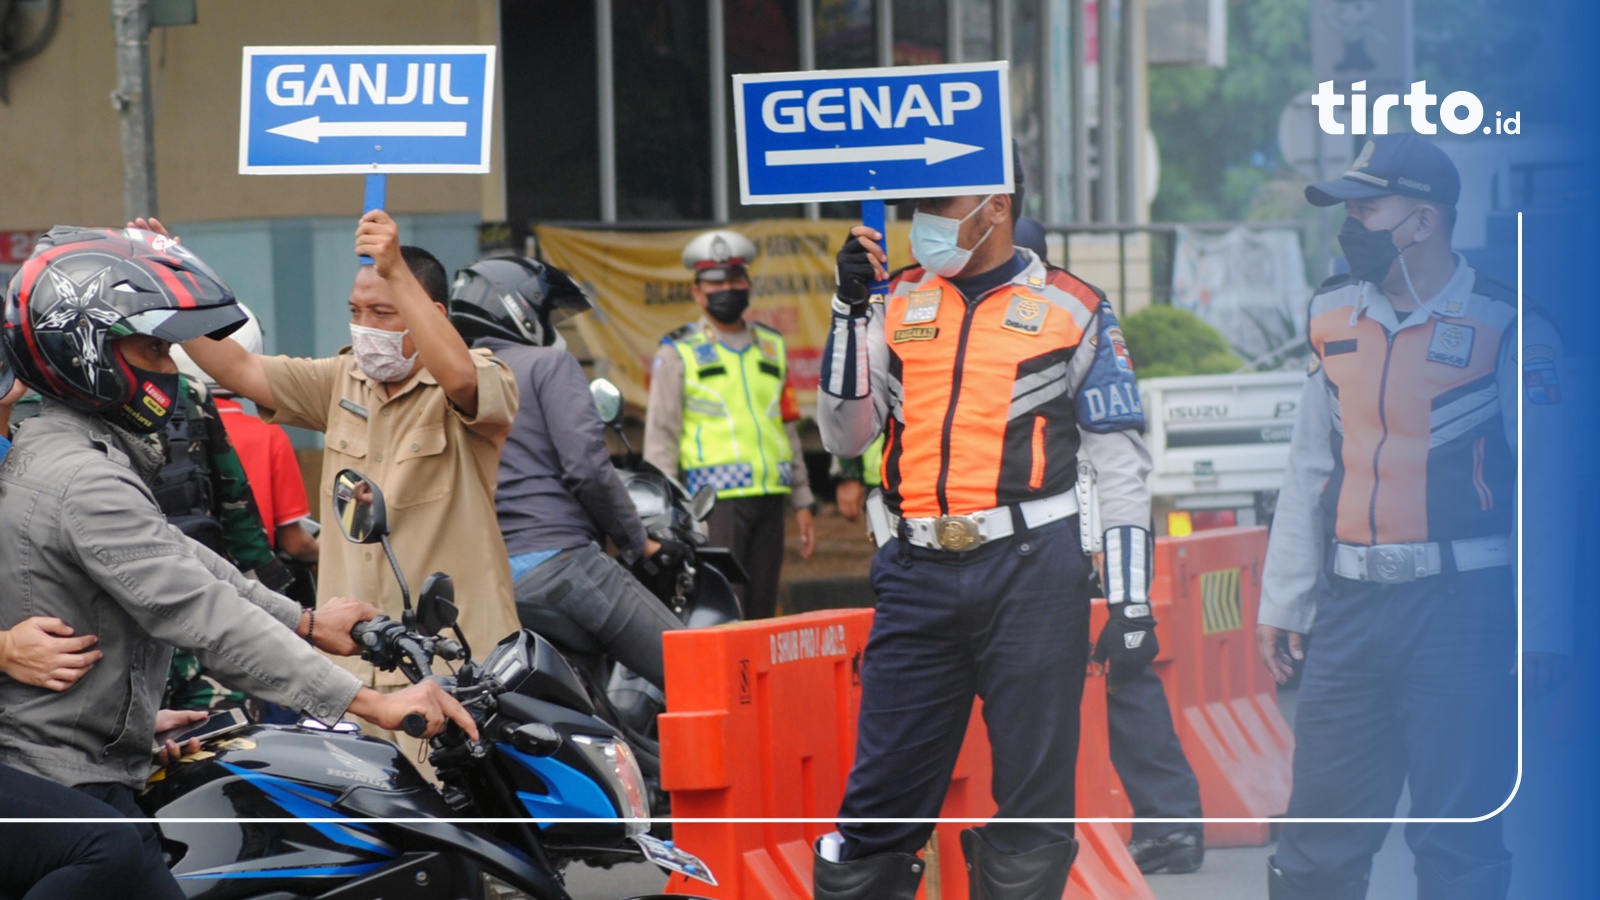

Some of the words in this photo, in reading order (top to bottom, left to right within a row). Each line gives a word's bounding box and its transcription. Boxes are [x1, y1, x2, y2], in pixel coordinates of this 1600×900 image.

[265, 63, 469, 106] GANJIL
[761, 81, 983, 134] GENAP
[1005, 319, 1038, 332] DISHUB
[1428, 351, 1466, 366] DISHUB
[1169, 404, 1229, 419] ISUZU
[770, 630, 799, 665] DSHUB
